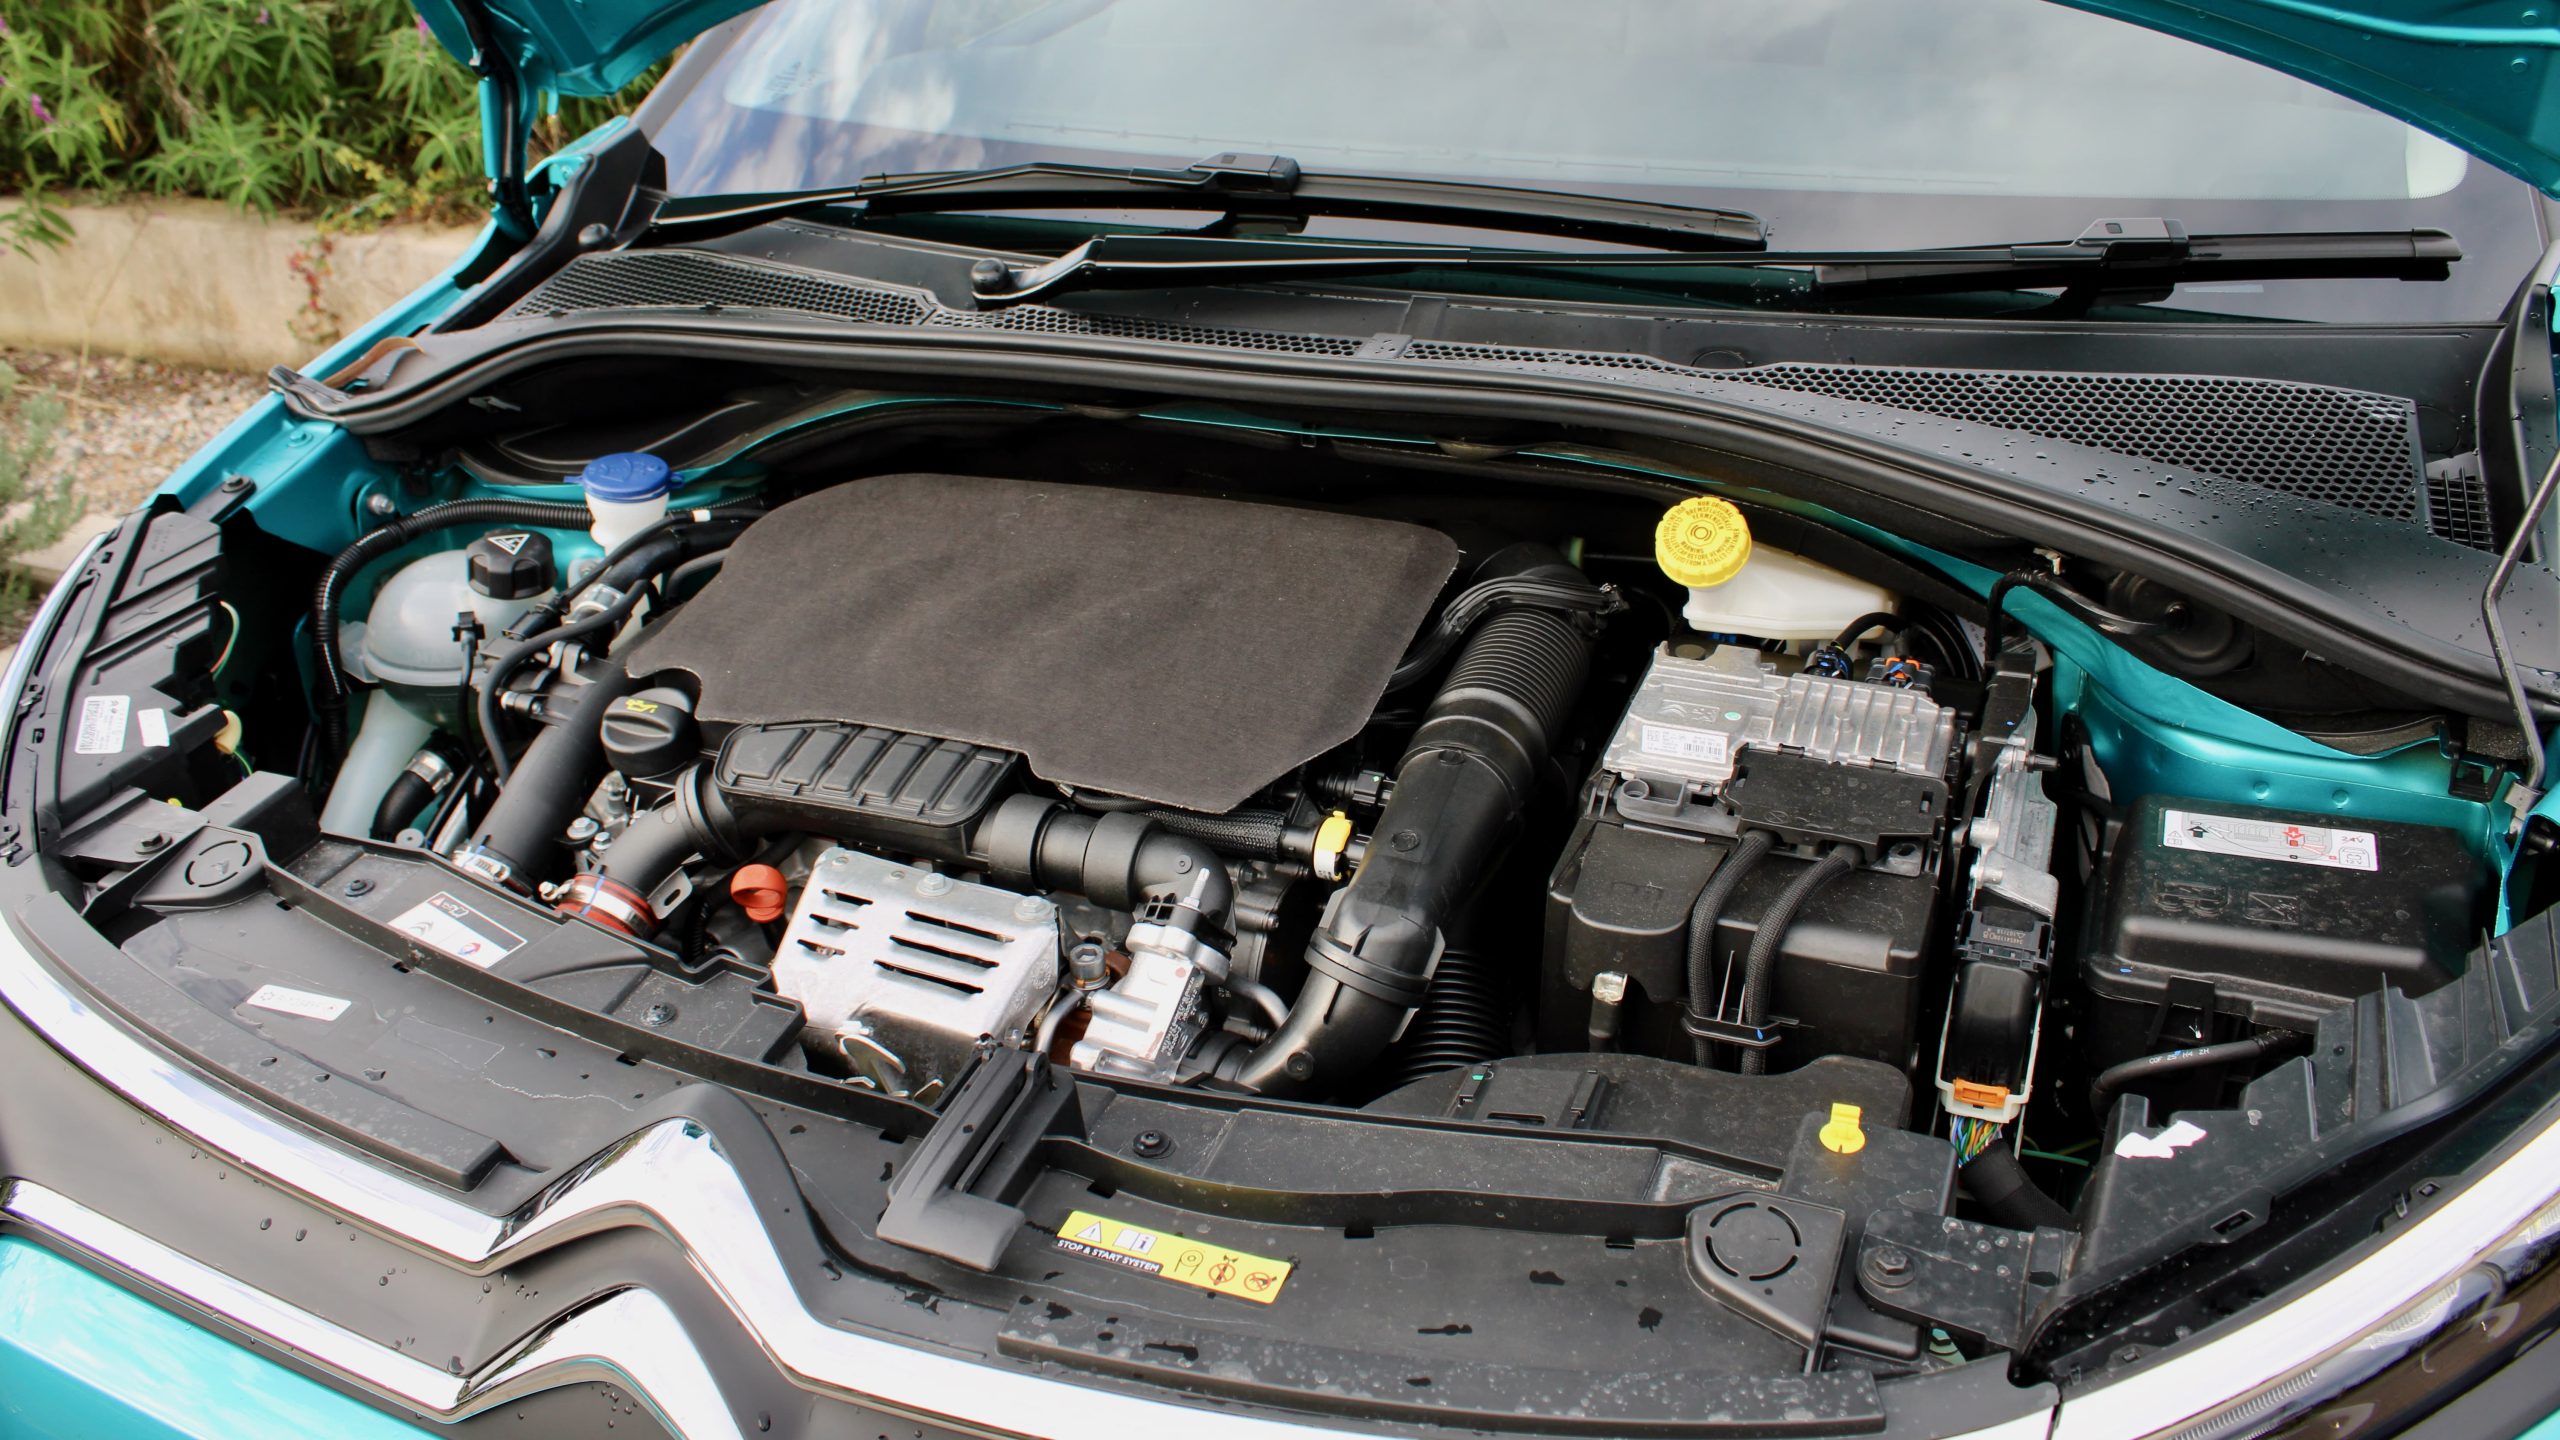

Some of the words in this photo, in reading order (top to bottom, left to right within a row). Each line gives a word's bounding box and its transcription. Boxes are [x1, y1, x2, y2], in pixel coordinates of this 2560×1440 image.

[1677, 546, 1688, 556] CAP
[1681, 541, 1704, 553] WARNING
[1057, 1240, 1083, 1251] STOP
[1082, 1246, 1091, 1255] &
[1091, 1248, 1123, 1263] START
[1122, 1257, 1160, 1272] SYSTEM
